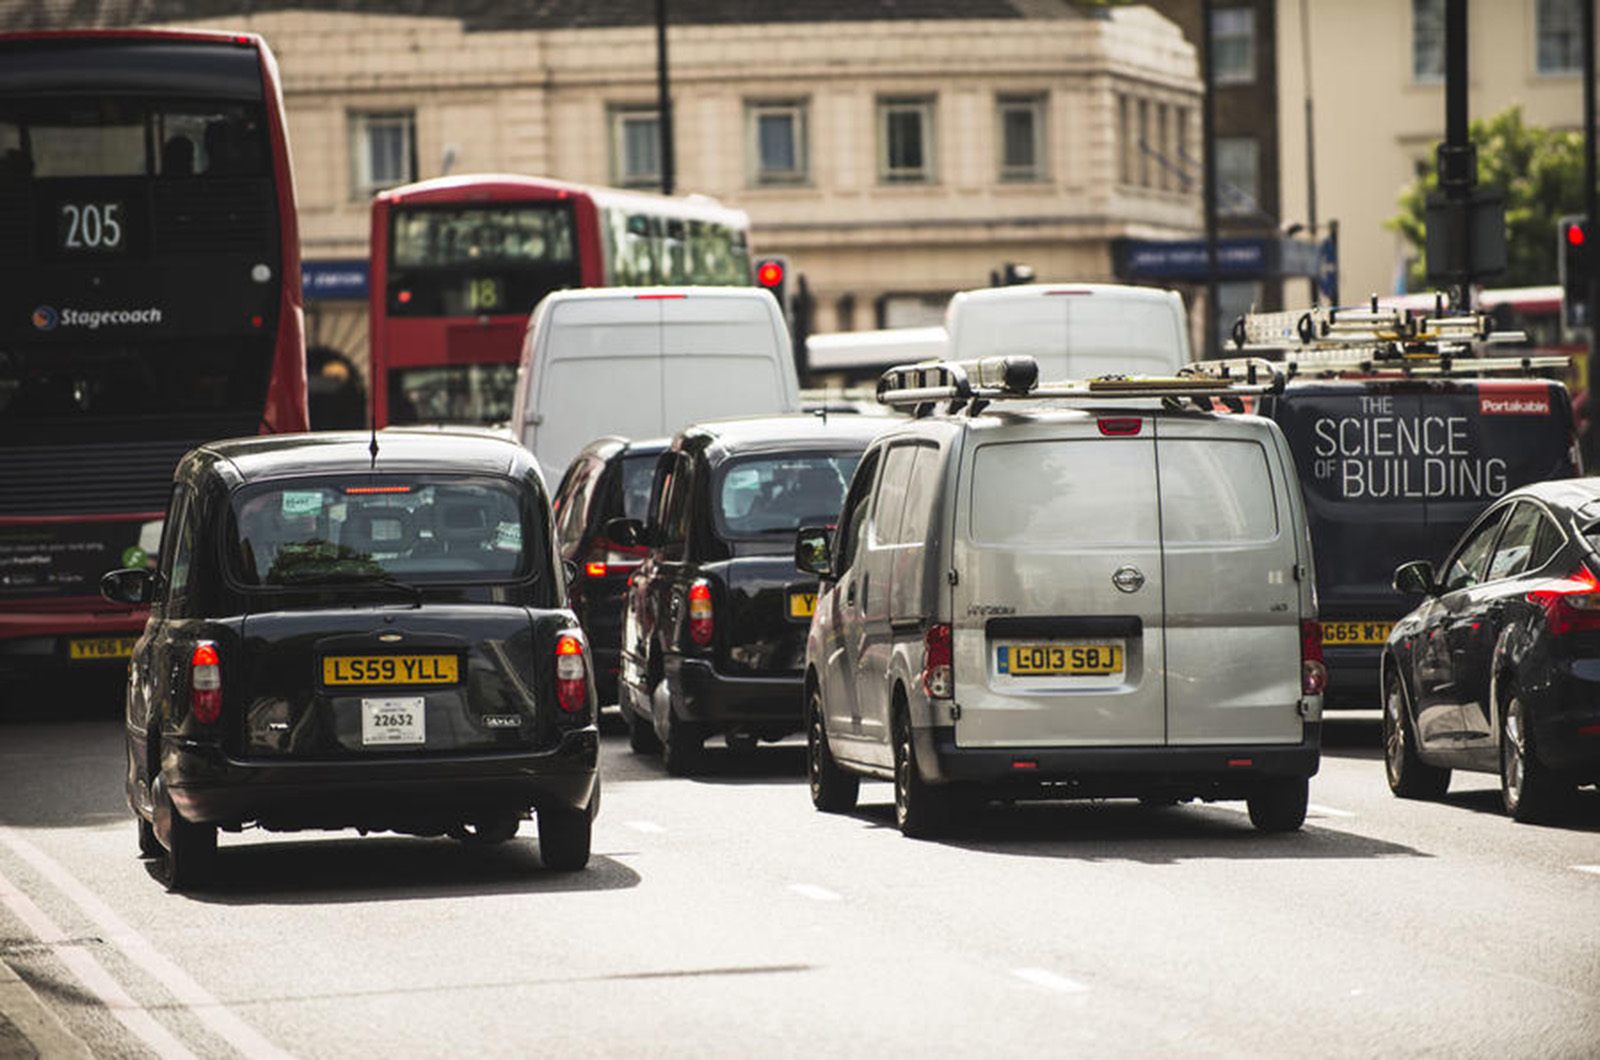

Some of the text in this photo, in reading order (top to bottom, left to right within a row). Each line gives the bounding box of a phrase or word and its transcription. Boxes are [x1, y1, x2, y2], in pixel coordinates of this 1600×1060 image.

[63, 204, 121, 247] 205
[471, 279, 497, 308] 18
[61, 307, 162, 328] Stagecoach
[1360, 396, 1393, 414] THE
[1482, 400, 1549, 412] Portakabin
[1315, 417, 1469, 456] SCIENCE
[1315, 458, 1507, 497] OF BUILDING
[1323, 624, 1360, 641] G65
[334, 658, 448, 681] LS59 YLL
[373, 713, 413, 727] 22632
